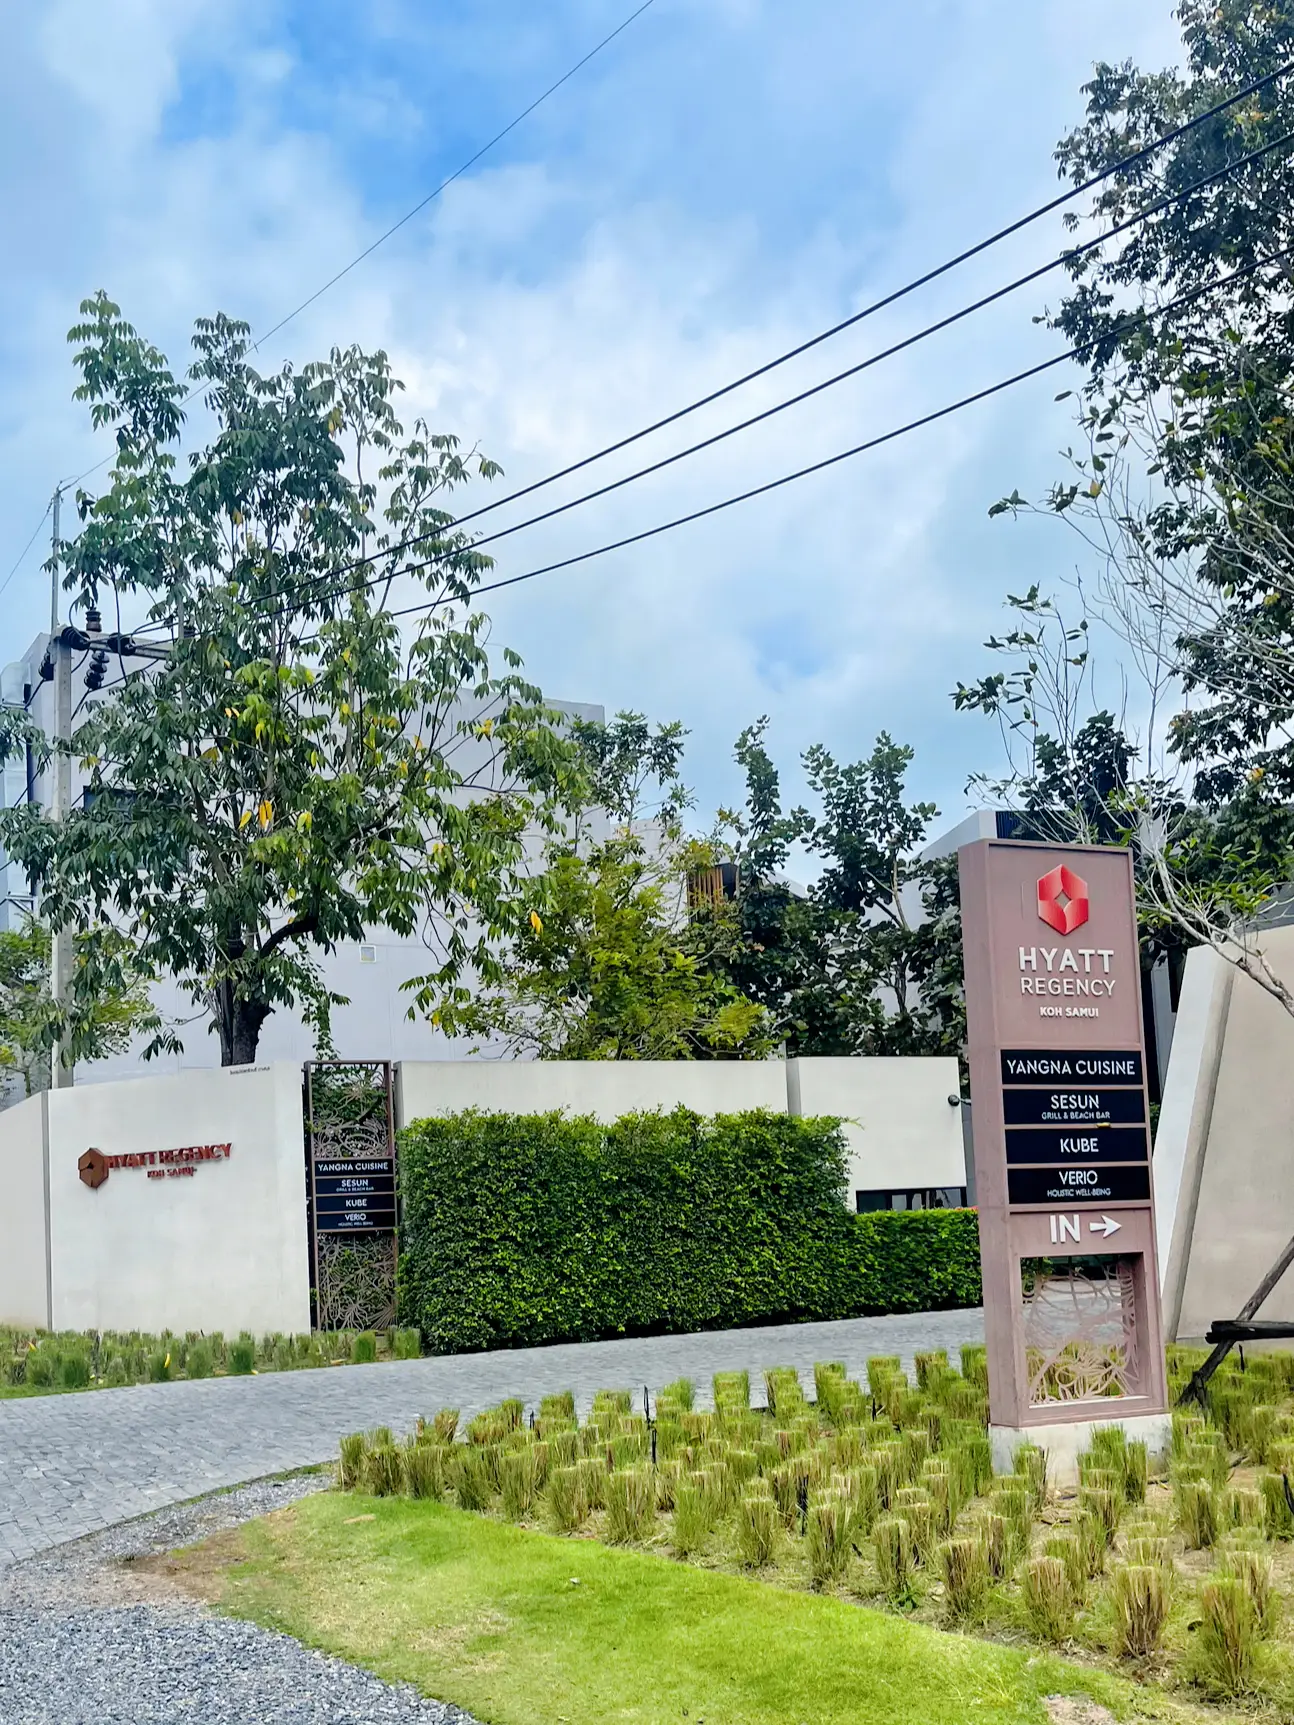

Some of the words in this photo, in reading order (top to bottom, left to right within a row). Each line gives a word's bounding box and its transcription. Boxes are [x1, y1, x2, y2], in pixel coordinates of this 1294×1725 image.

[1018, 947, 1114, 973] HYATT
[1020, 977, 1116, 997] REGENCY
[1040, 1006, 1063, 1017] KOH
[1065, 1007, 1099, 1018] SAMUI
[1007, 1059, 1072, 1075] YANGNA
[1075, 1060, 1136, 1075] CUISINE
[1050, 1094, 1100, 1110] SESUN
[1041, 1112, 1062, 1120] GRILL
[1063, 1112, 1069, 1120] &
[1069, 1111, 1095, 1120] BEACH
[1096, 1111, 1111, 1119] BAR
[1060, 1137, 1099, 1153] KUBE
[105, 1151, 158, 1169] HYATT
[158, 1143, 232, 1165] REGENCY
[318, 1163, 354, 1172] YANGNA
[355, 1161, 389, 1171] CUISINE
[341, 1179, 369, 1188] SESUN
[1058, 1170, 1098, 1185] VERIO
[345, 1198, 368, 1207] KUBE
[345, 1213, 367, 1221] VERIO
[1050, 1214, 1081, 1244] IN
